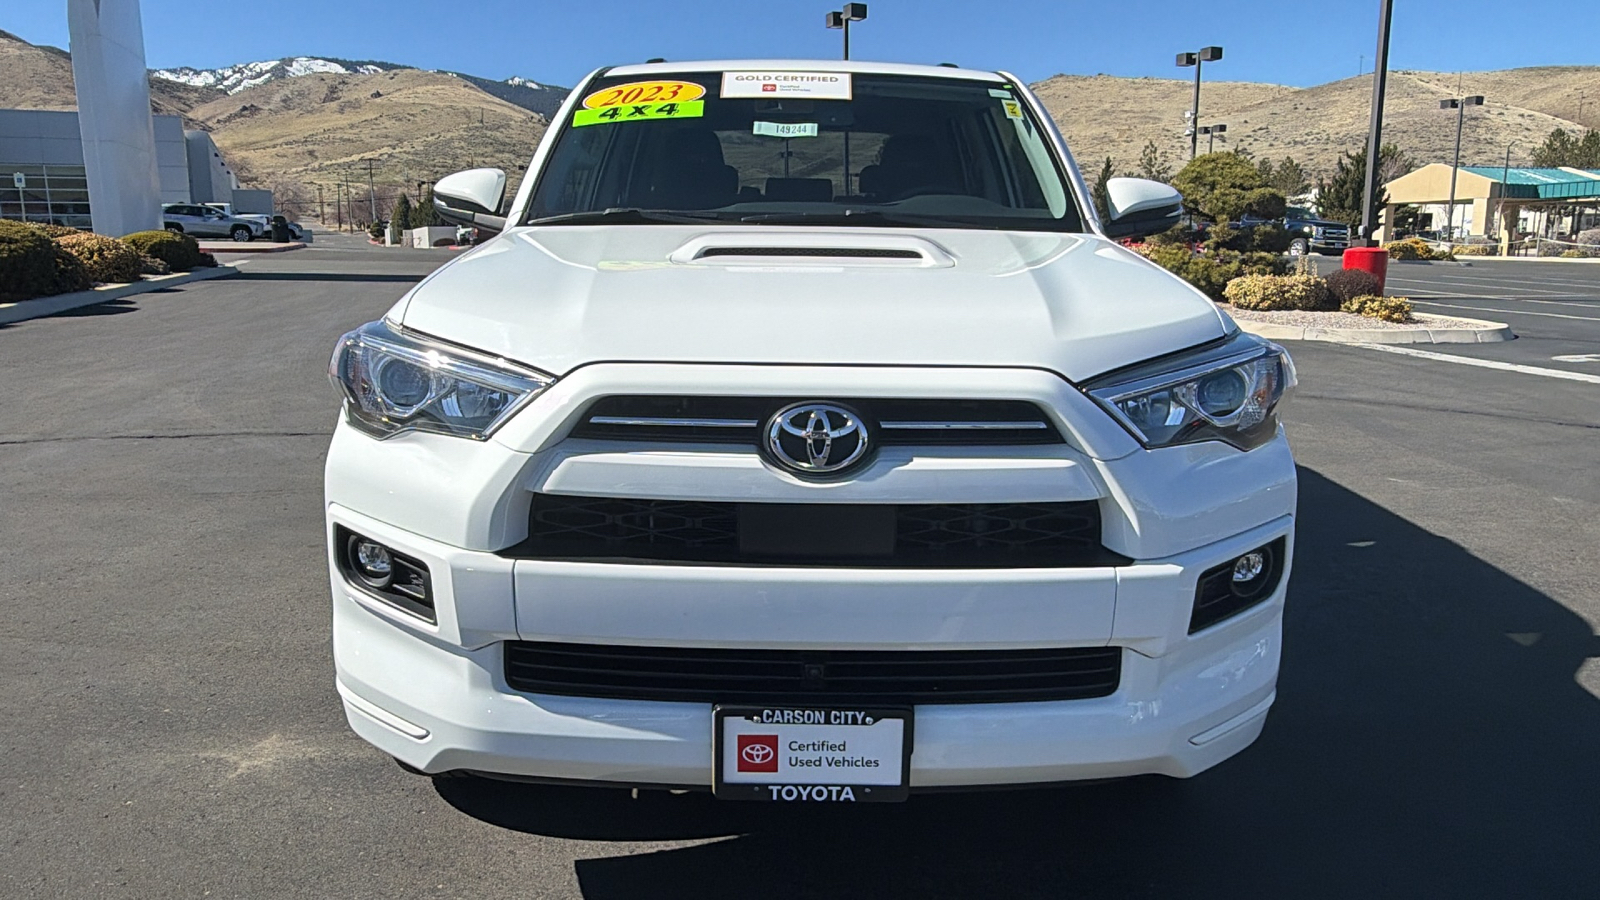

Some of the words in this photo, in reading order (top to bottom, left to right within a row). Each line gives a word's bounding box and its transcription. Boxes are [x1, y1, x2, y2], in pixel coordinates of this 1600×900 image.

[774, 75, 839, 83] CERTIFIED
[600, 85, 683, 107] 2023
[775, 125, 807, 134] 149244
[762, 709, 825, 725] CARSON
[830, 711, 866, 725] CITY
[788, 740, 846, 752] Certified
[788, 756, 822, 767] Used
[826, 757, 880, 768] Vehicles
[768, 785, 856, 802] TOYOTA
